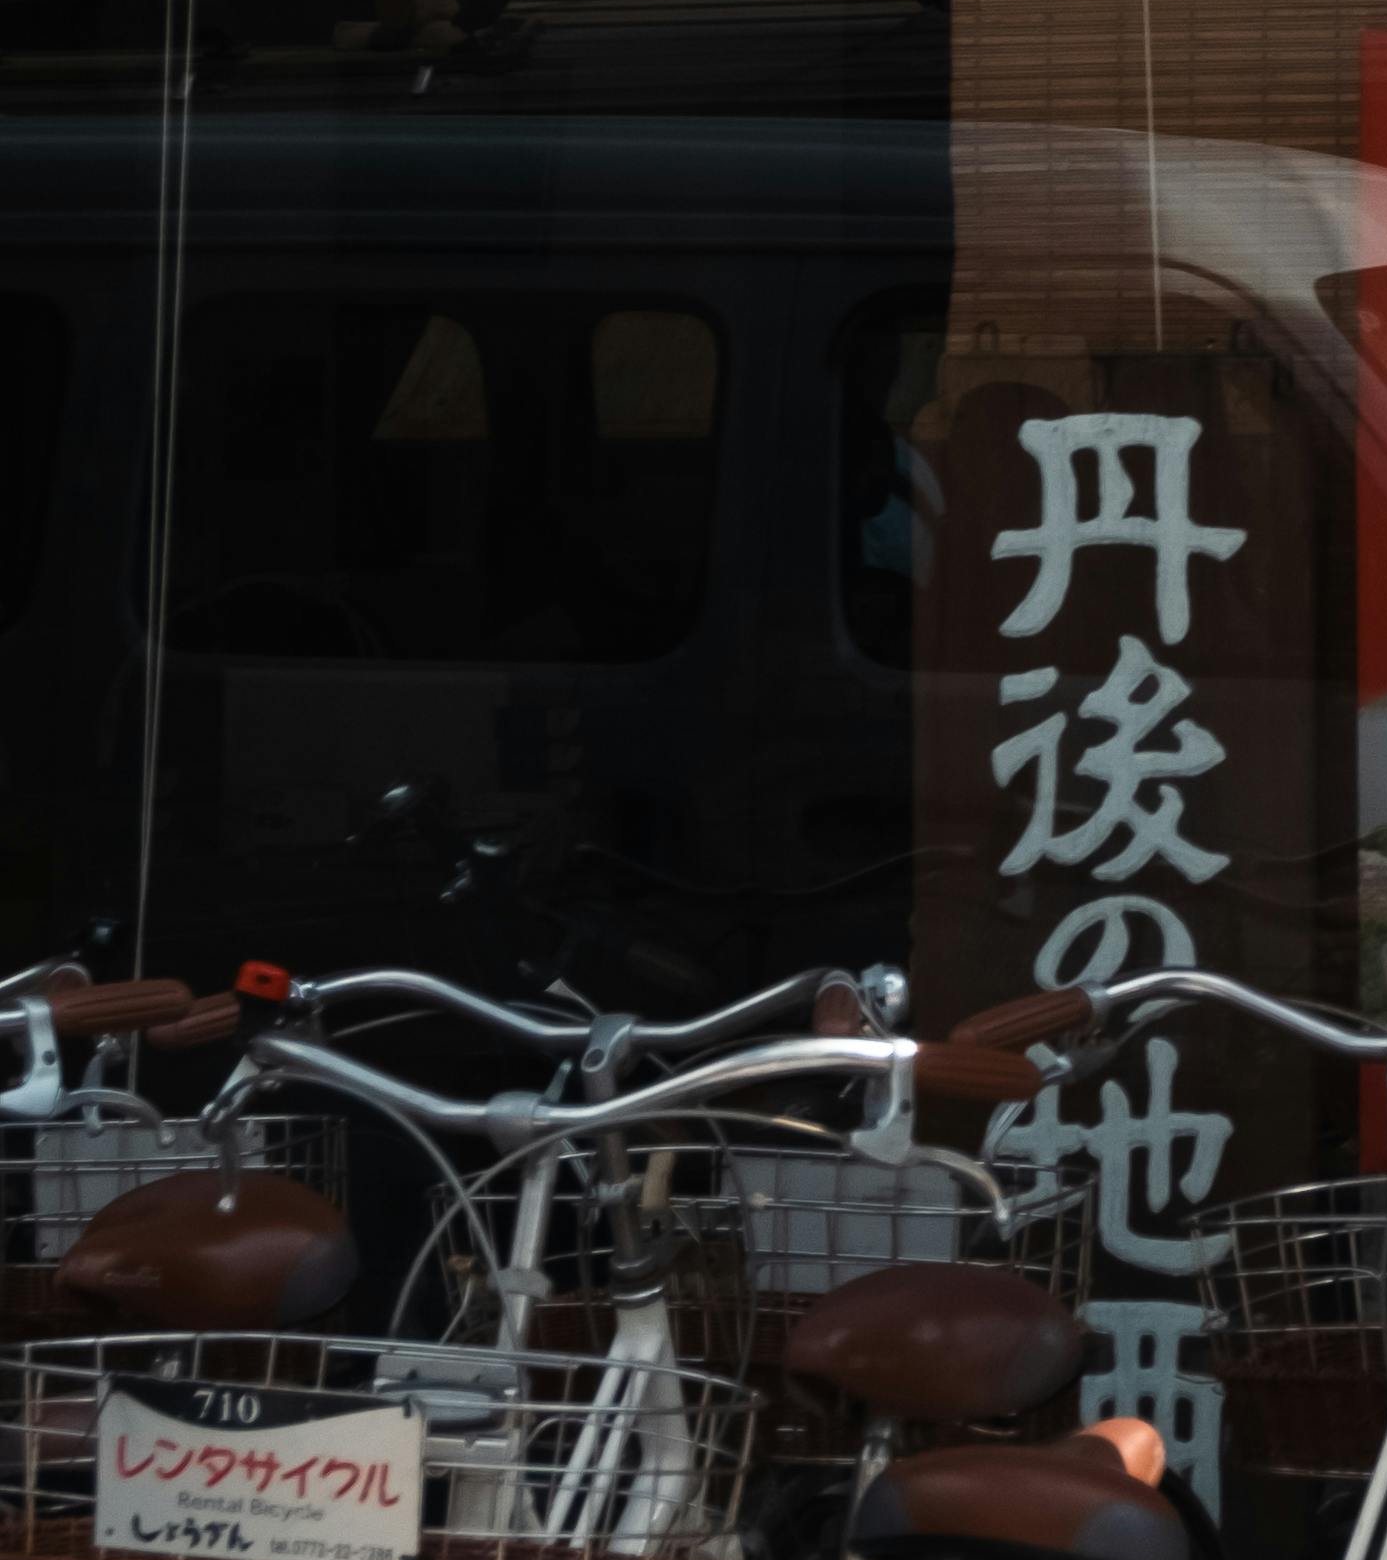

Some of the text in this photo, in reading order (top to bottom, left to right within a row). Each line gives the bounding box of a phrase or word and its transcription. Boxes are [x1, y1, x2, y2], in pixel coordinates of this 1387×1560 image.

[192, 1388, 262, 1424] 710
[117, 1435, 400, 1507] レンタサイクル
[178, 1491, 325, 1523] Rental Bicycle
